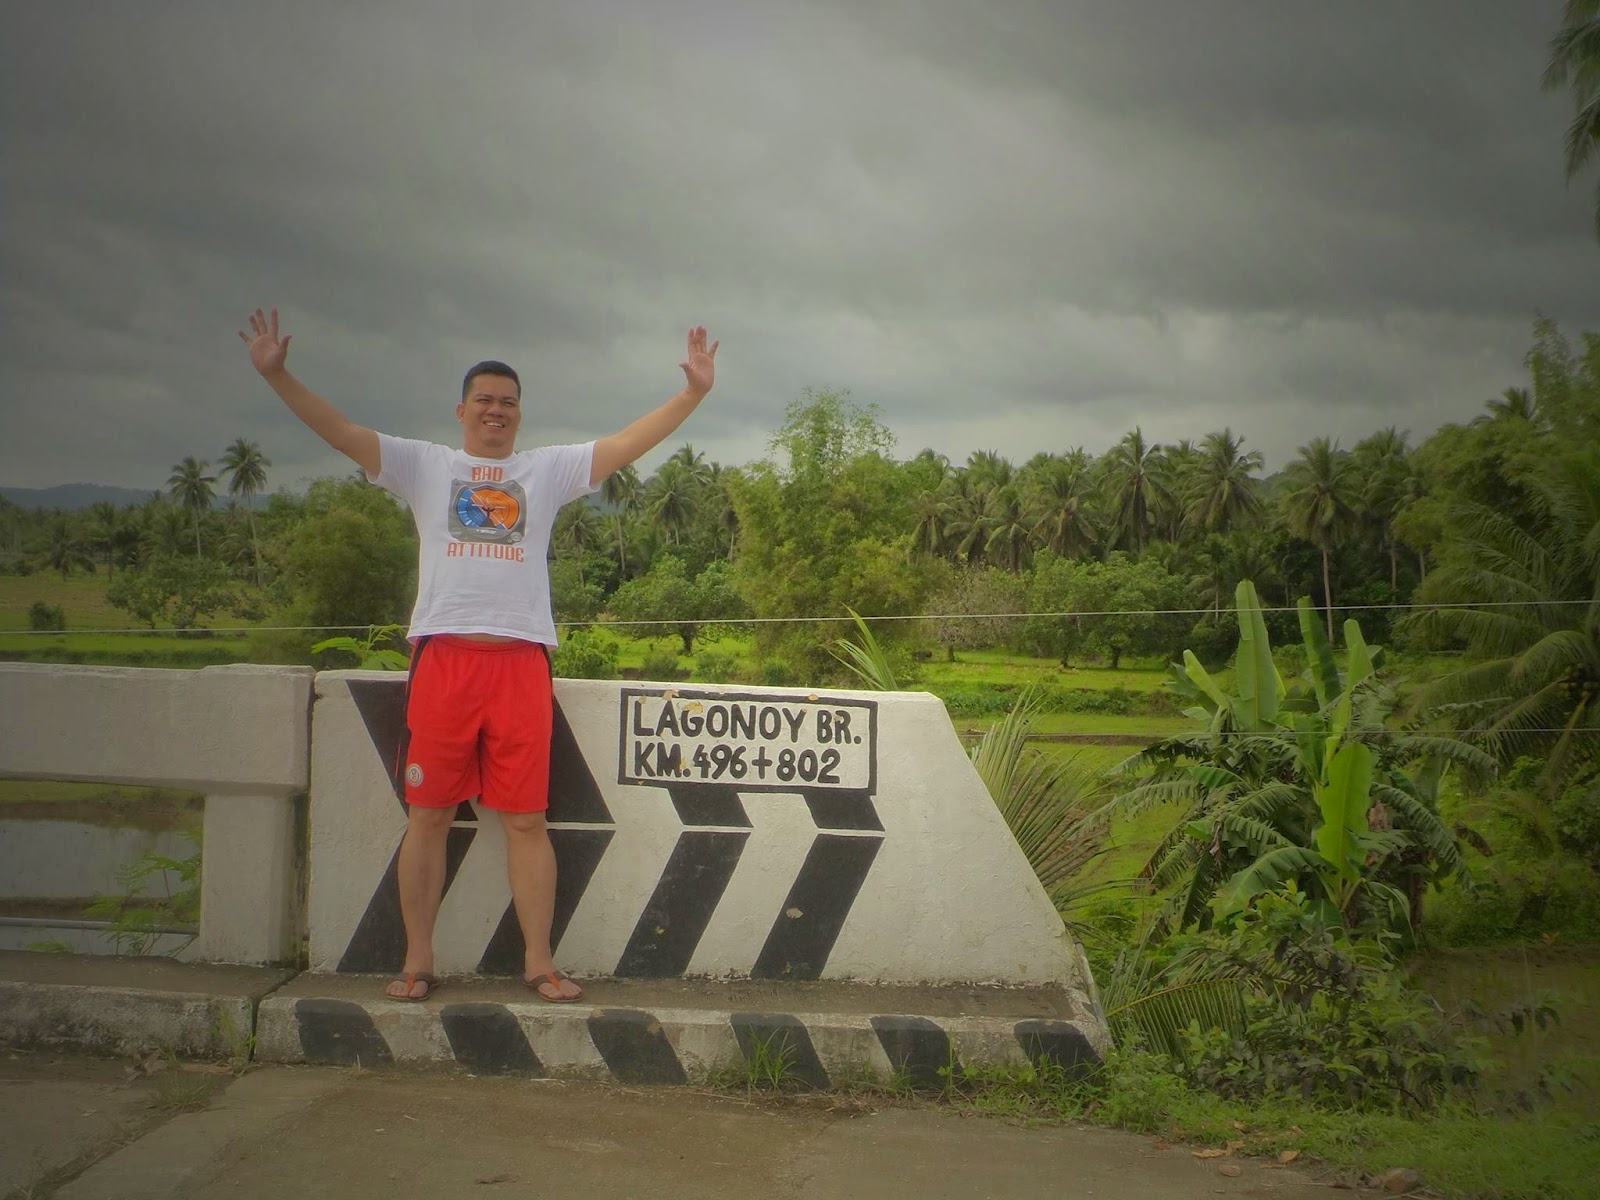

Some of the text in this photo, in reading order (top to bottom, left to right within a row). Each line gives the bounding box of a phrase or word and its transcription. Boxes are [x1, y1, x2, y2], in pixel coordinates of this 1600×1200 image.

[471, 466, 504, 481] BAD
[447, 542, 525, 562] ATTITUDE
[633, 700, 862, 744] LAGONOY BR.
